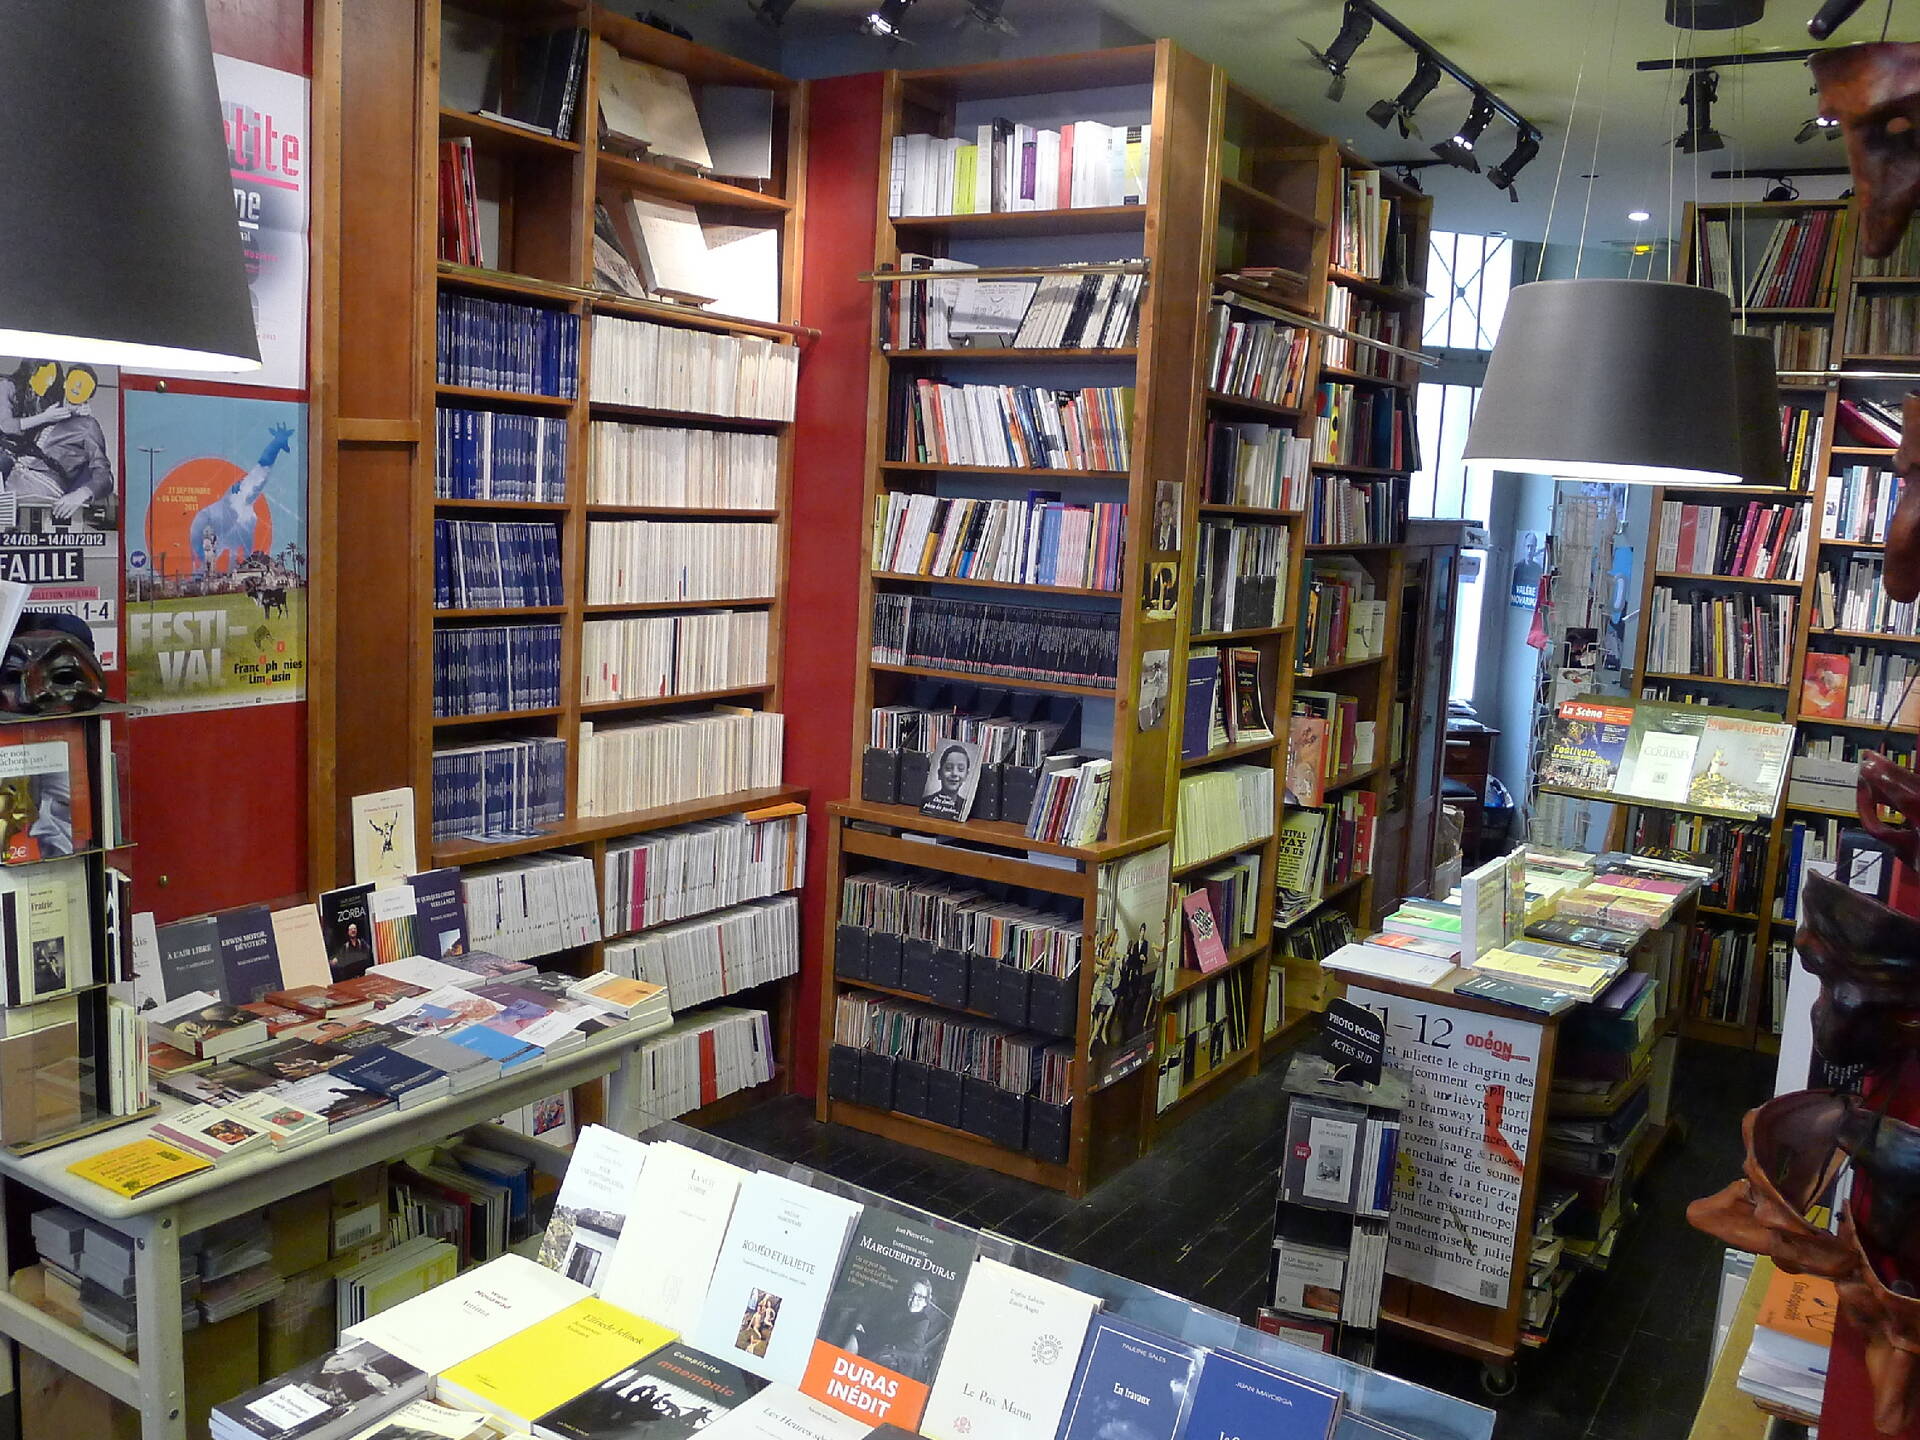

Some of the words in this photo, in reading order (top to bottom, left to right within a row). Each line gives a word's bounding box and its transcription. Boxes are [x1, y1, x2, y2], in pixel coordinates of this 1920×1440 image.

[223, 107, 299, 177] tite
[337, 906, 366, 923] ZORBA
[1329, 1012, 1354, 1031] PHOTO
[1355, 1025, 1380, 1044] POCHE
[1331, 1039, 1356, 1056] ACTES
[1356, 1050, 1373, 1064] SUD
[1403, 1048, 1443, 1065] juliette
[1448, 1057, 1459, 1069] le
[1463, 1061, 1510, 1082] chagrin
[1515, 1073, 1534, 1088] des
[1475, 1080, 1532, 1104] expliquer
[1418, 1115, 1434, 1129] les
[1511, 1139, 1526, 1152] de
[1420, 1100, 1475, 1122] tramway
[1479, 1113, 1490, 1127] la
[1498, 1120, 1528, 1137] dame
[1407, 1164, 1434, 1178] casa
[1439, 1171, 1454, 1184] de
[1459, 1175, 1471, 1188] la
[1477, 1180, 1518, 1202] fuerza
[1463, 1160, 1481, 1174] die
[1486, 1167, 1520, 1186] sonne
[1408, 1176, 1422, 1189] de
[1427, 1181, 1440, 1194] la
[1496, 1203, 1518, 1216] der
[1443, 1218, 1469, 1233] pour
[859, 1235, 922, 1269] MARGUERITE
[922, 1257, 957, 1281] DURAS
[1404, 1238, 1421, 1250] ma
[1424, 1244, 1473, 1268] chambre
[1475, 1259, 1510, 1279] froide
[1483, 1246, 1511, 1263] julie
[614, 1326, 645, 1346] Jelinek
[672, 1351, 721, 1374] Complicite
[1122, 1342, 1147, 1357] PAULINE
[1148, 1351, 1167, 1364] SALES
[657, 1360, 737, 1397] mnemonic
[833, 1357, 899, 1398] DURAS
[826, 1377, 892, 1419] INÉDIT
[1113, 1382, 1125, 1395] En
[1125, 1387, 1151, 1406] travaux
[1256, 1388, 1294, 1408] MAYORGA
[763, 1408, 779, 1420] Les
[779, 1415, 812, 1437] Heures
